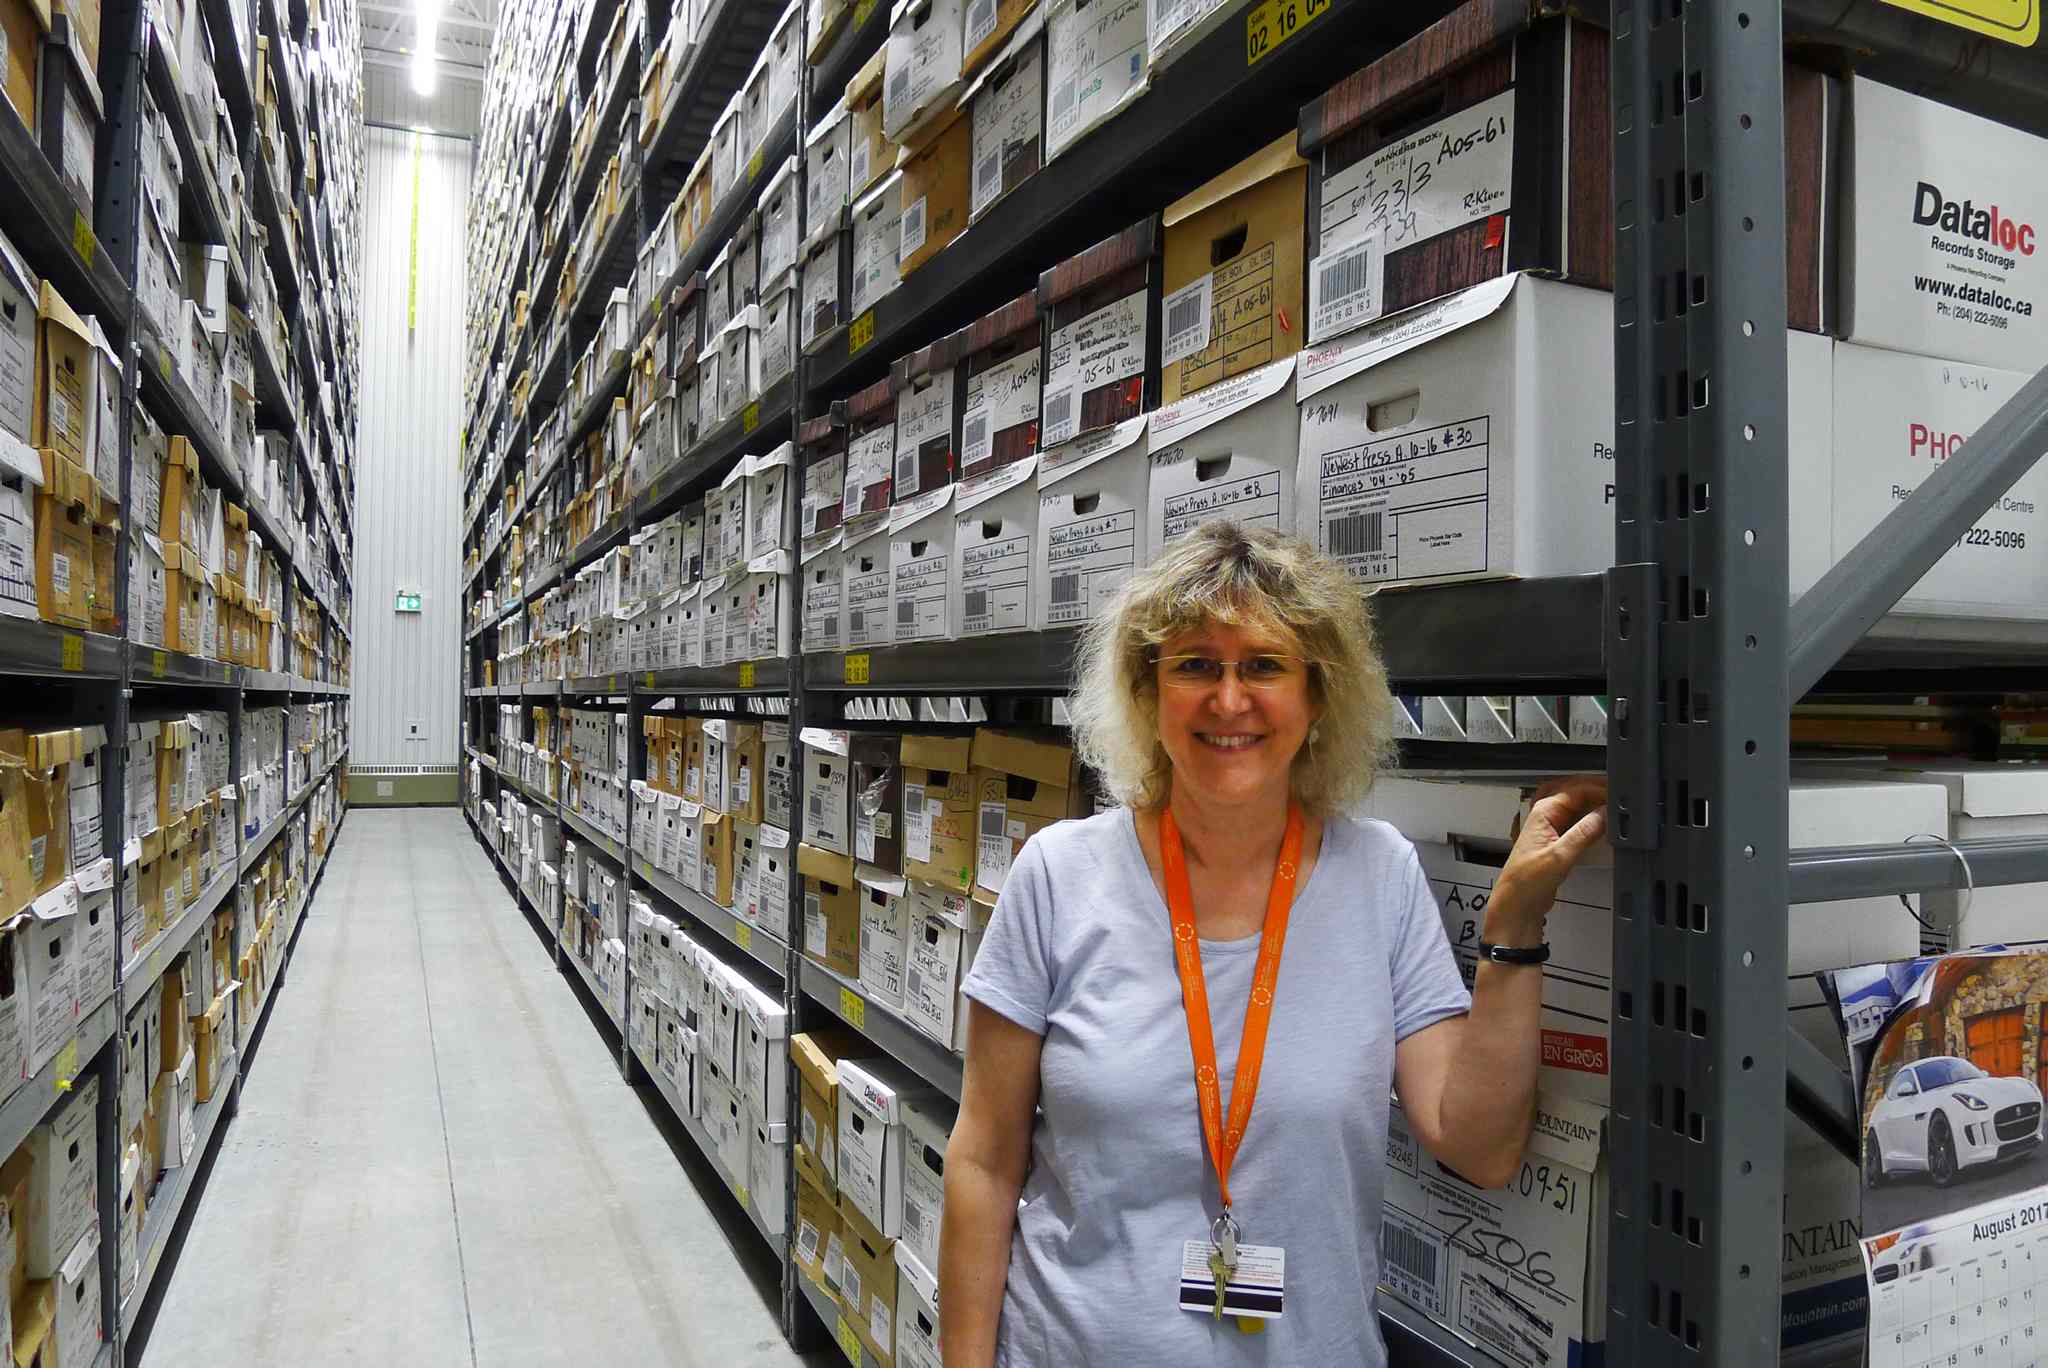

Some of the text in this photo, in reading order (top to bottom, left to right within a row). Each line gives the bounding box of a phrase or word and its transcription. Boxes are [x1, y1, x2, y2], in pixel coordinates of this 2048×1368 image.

[1250, 0, 1326, 58] 02 16 0
[1913, 181, 2035, 256] Dataloc
[1931, 235, 2016, 270] Records Storage
[1914, 275, 2033, 317] www.dataloc.ca
[1937, 301, 1951, 316] Ph:
[1952, 305, 1973, 324] (204)
[1910, 423, 1968, 461] PHO
[1362, 446, 1392, 469] Press
[1892, 485, 1913, 501] Rec
[2003, 497, 2034, 514] Centre
[1966, 528, 2025, 549] 222-5096
[1445, 885, 1490, 912] A.0
[1544, 1045, 1604, 1068] EN GROS
[1972, 1203, 2048, 1242] August 2017
[1437, 1209, 1556, 1286] 7506
[1998, 1296, 2008, 1309] 10
[2023, 1289, 2032, 1301] 11
[1974, 1345, 1984, 1357] 16
[2000, 1335, 2009, 1347] 17
